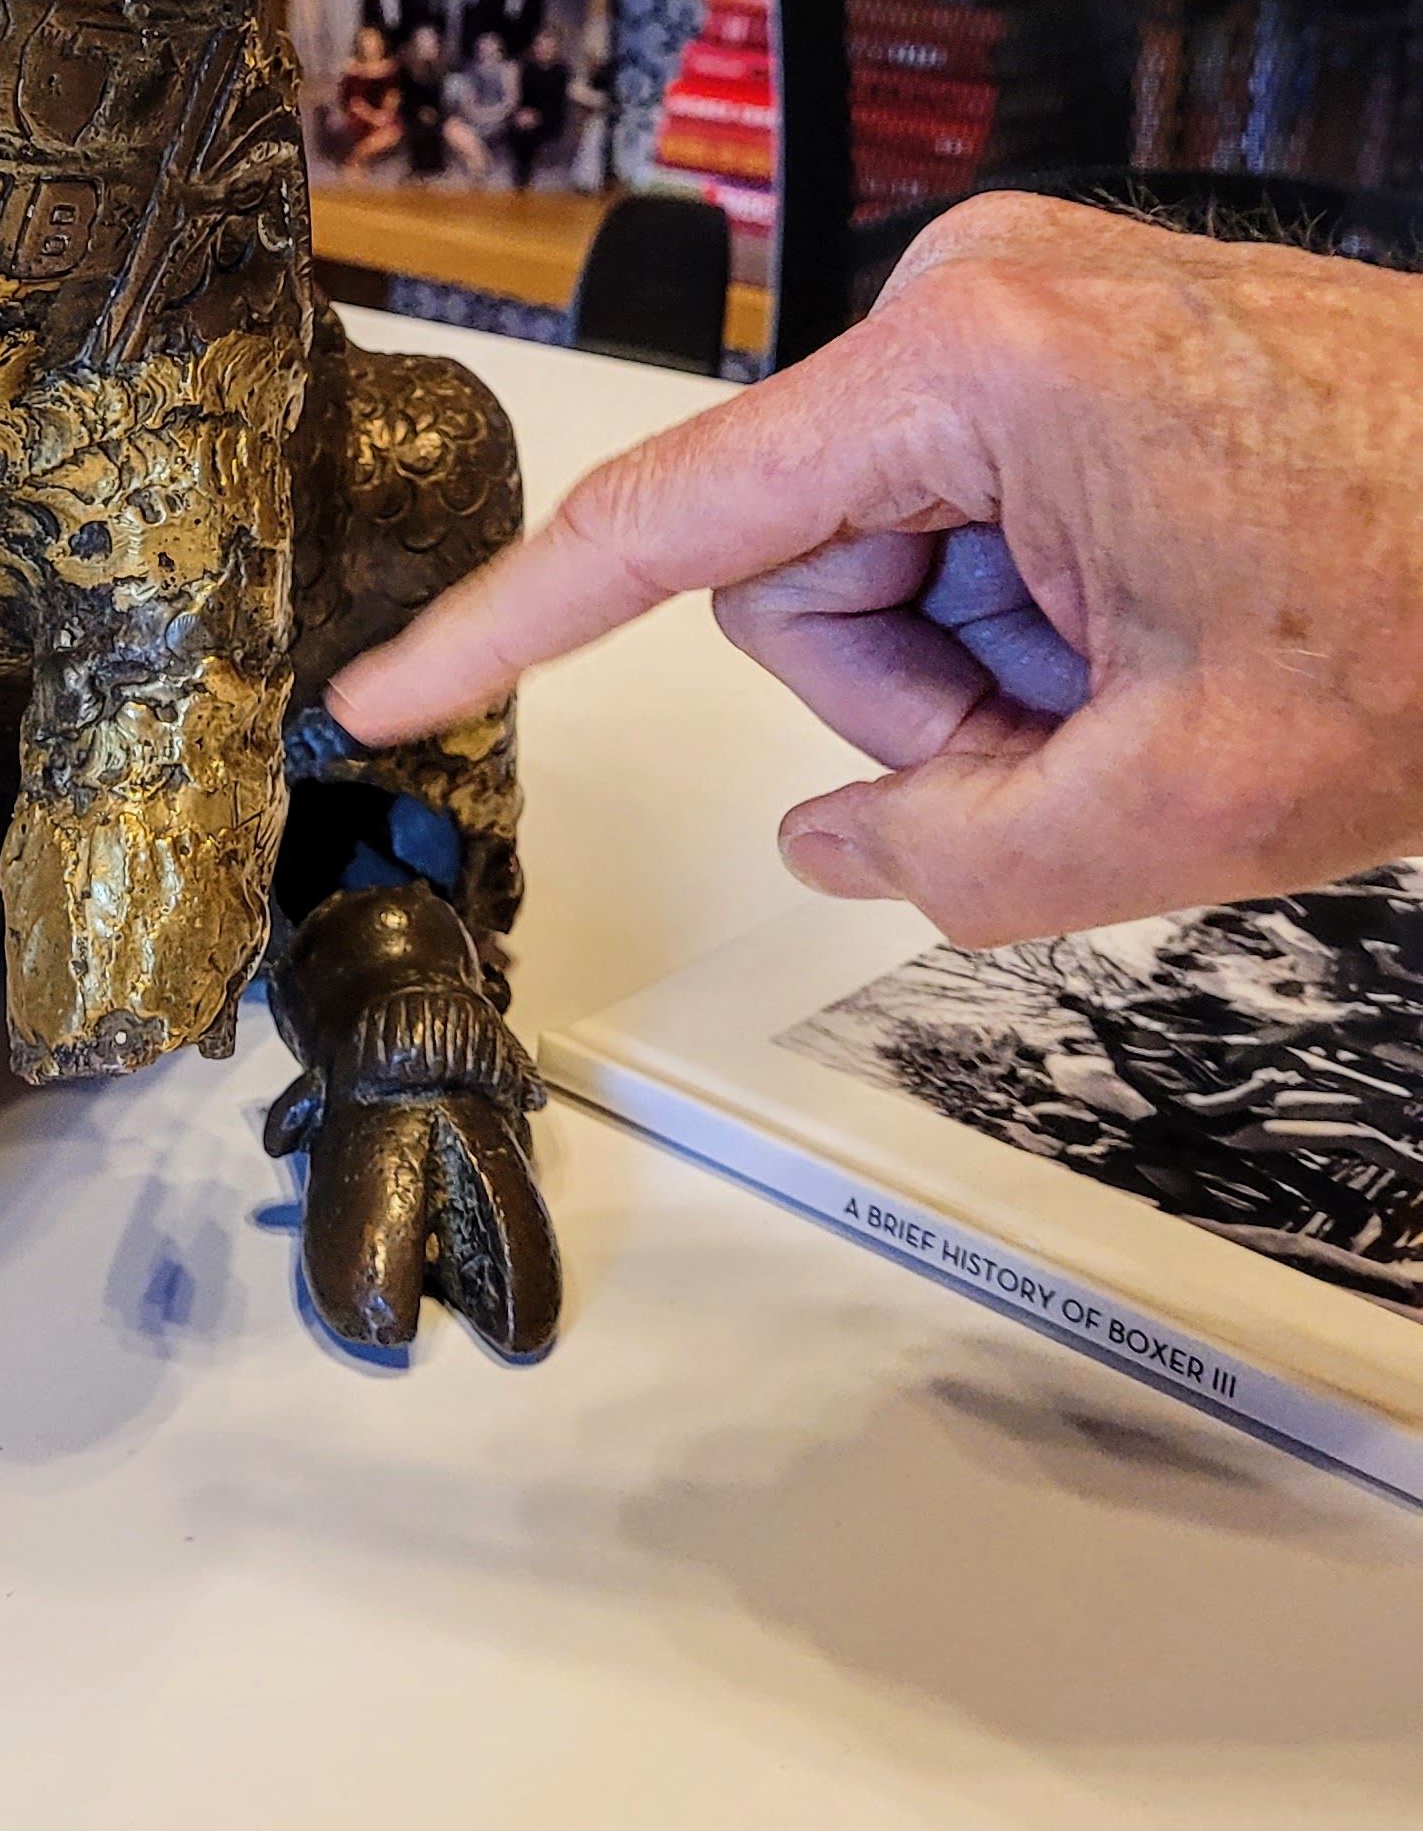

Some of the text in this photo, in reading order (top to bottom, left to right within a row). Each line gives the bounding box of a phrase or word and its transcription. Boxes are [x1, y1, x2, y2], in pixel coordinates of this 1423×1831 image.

[843, 1197, 1236, 1399] A BRIEF HISTORY OF BOXER III
